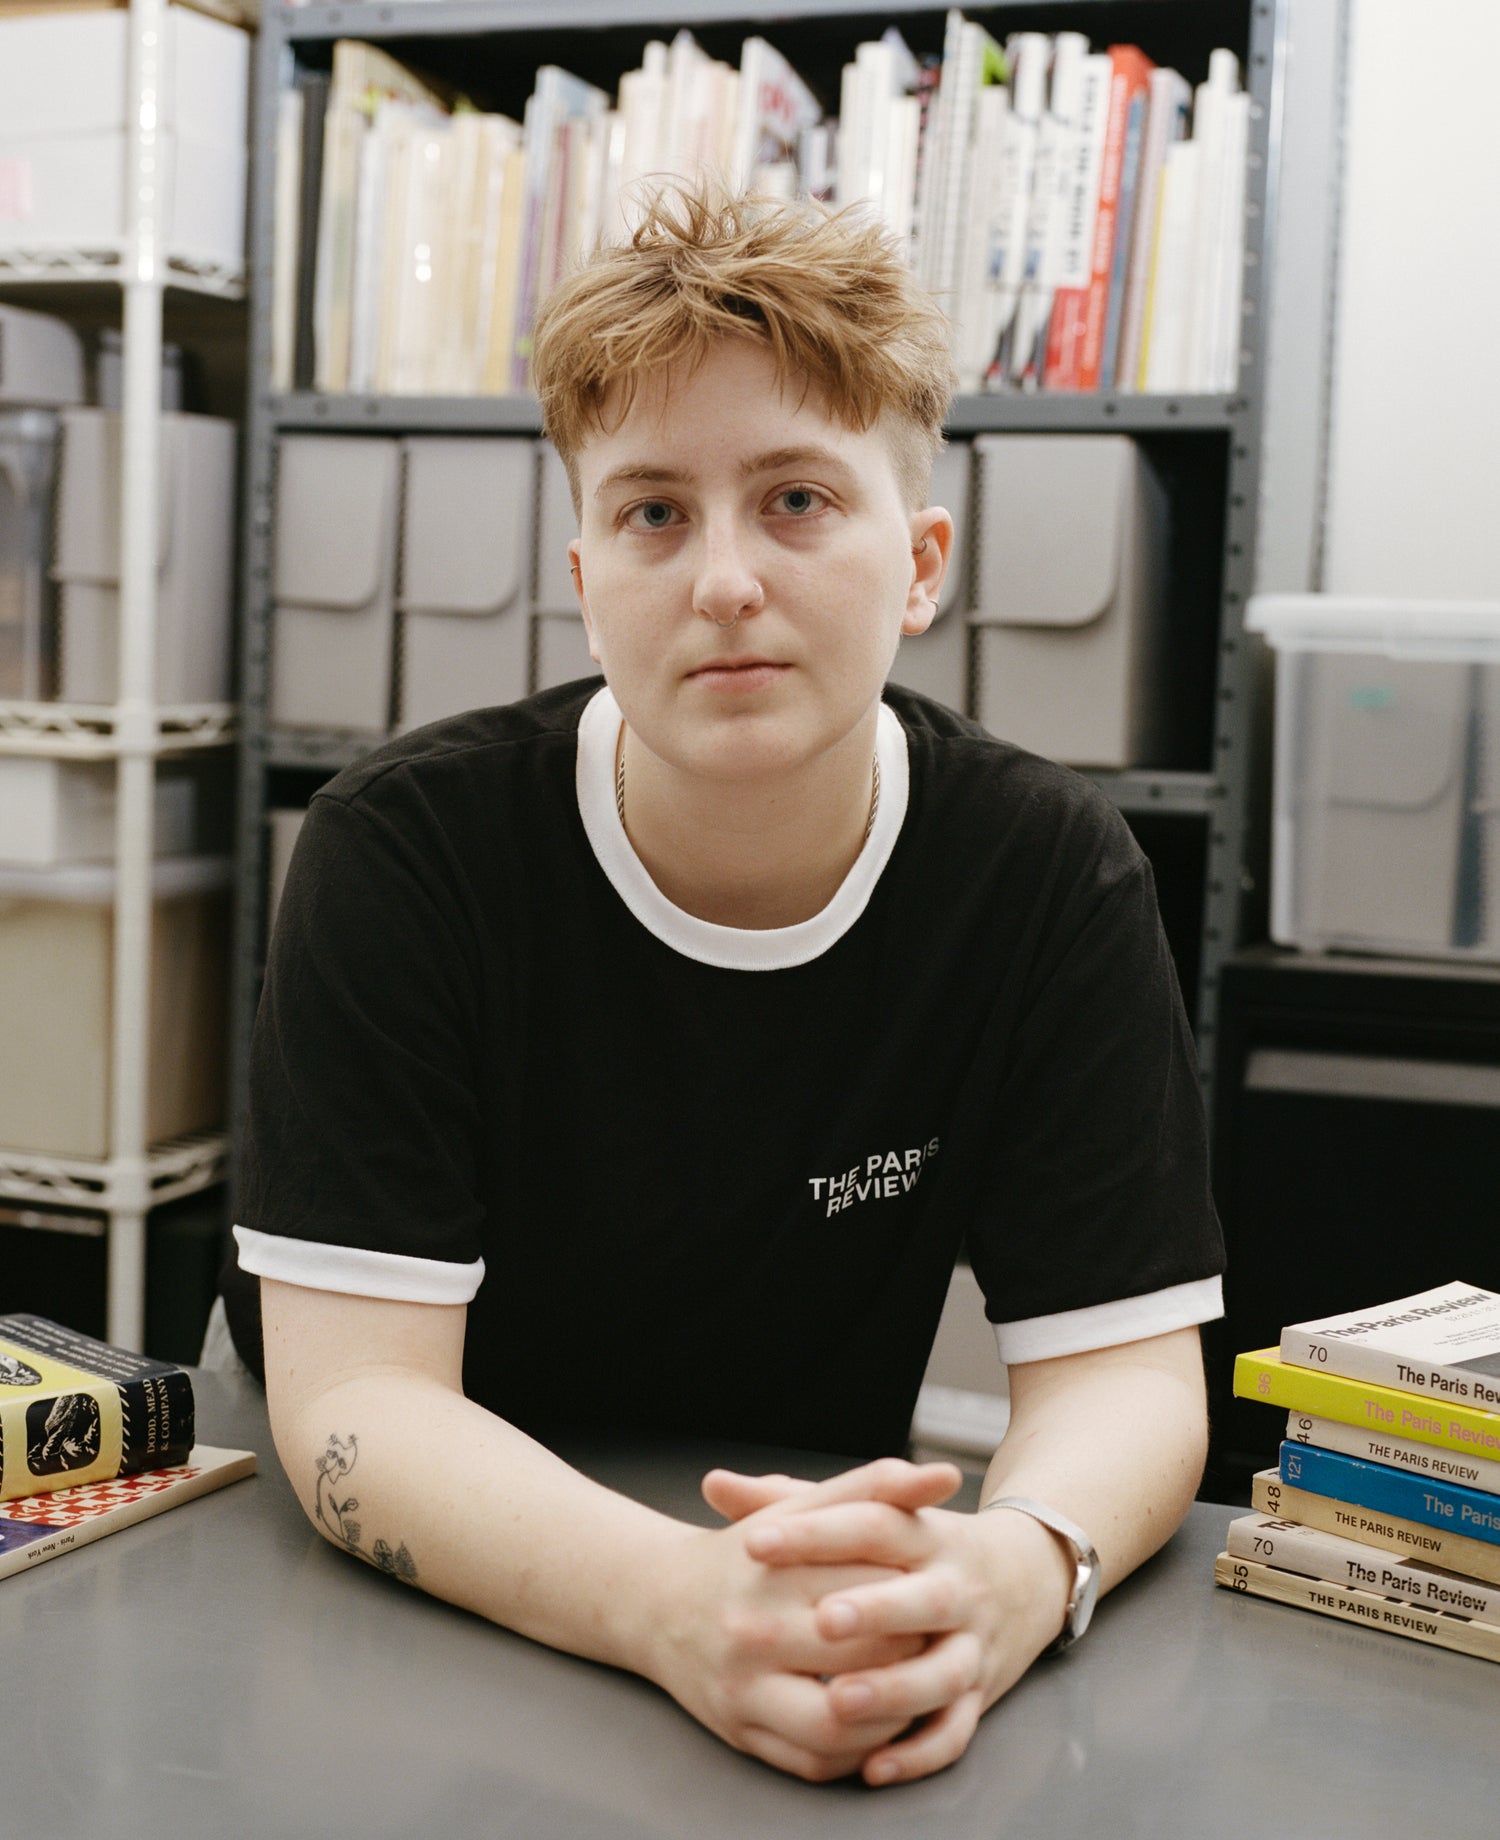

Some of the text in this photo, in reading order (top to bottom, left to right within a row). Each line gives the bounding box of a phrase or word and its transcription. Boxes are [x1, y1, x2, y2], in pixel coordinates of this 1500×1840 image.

[808, 1137, 939, 1200] THE PARIS
[826, 1167, 922, 1218] REVIEW
[1312, 1326, 1368, 1339] The
[1354, 1313, 1423, 1331] Paris
[1408, 1293, 1492, 1318] Review
[1308, 1344, 1328, 1363] 70
[142, 1378, 156, 1413] MEAD
[1257, 1373, 1271, 1396] 96
[1396, 1364, 1425, 1386] The
[1430, 1372, 1468, 1396] Paris
[155, 1377, 170, 1452] & COMPANY
[1296, 1417, 1312, 1443] 46
[1364, 1400, 1395, 1423] The
[1401, 1410, 1442, 1435] Paris
[1288, 1454, 1302, 1480] 121
[1368, 1442, 1479, 1481] THE PARIS REVIEW
[1267, 1485, 1281, 1513] 48
[1423, 1493, 1500, 1530] The Paris
[42, 1543, 56, 1553] New
[60, 1535, 75, 1546] Paris
[1253, 1537, 1274, 1556] 70
[1335, 1511, 1442, 1552] THE PARIS REVIEW
[27, 1550, 42, 1560] York
[1232, 1564, 1249, 1591] 55
[1346, 1560, 1487, 1612] The Paris Review
[1308, 1591, 1438, 1635] THE PARIS REVIEW
